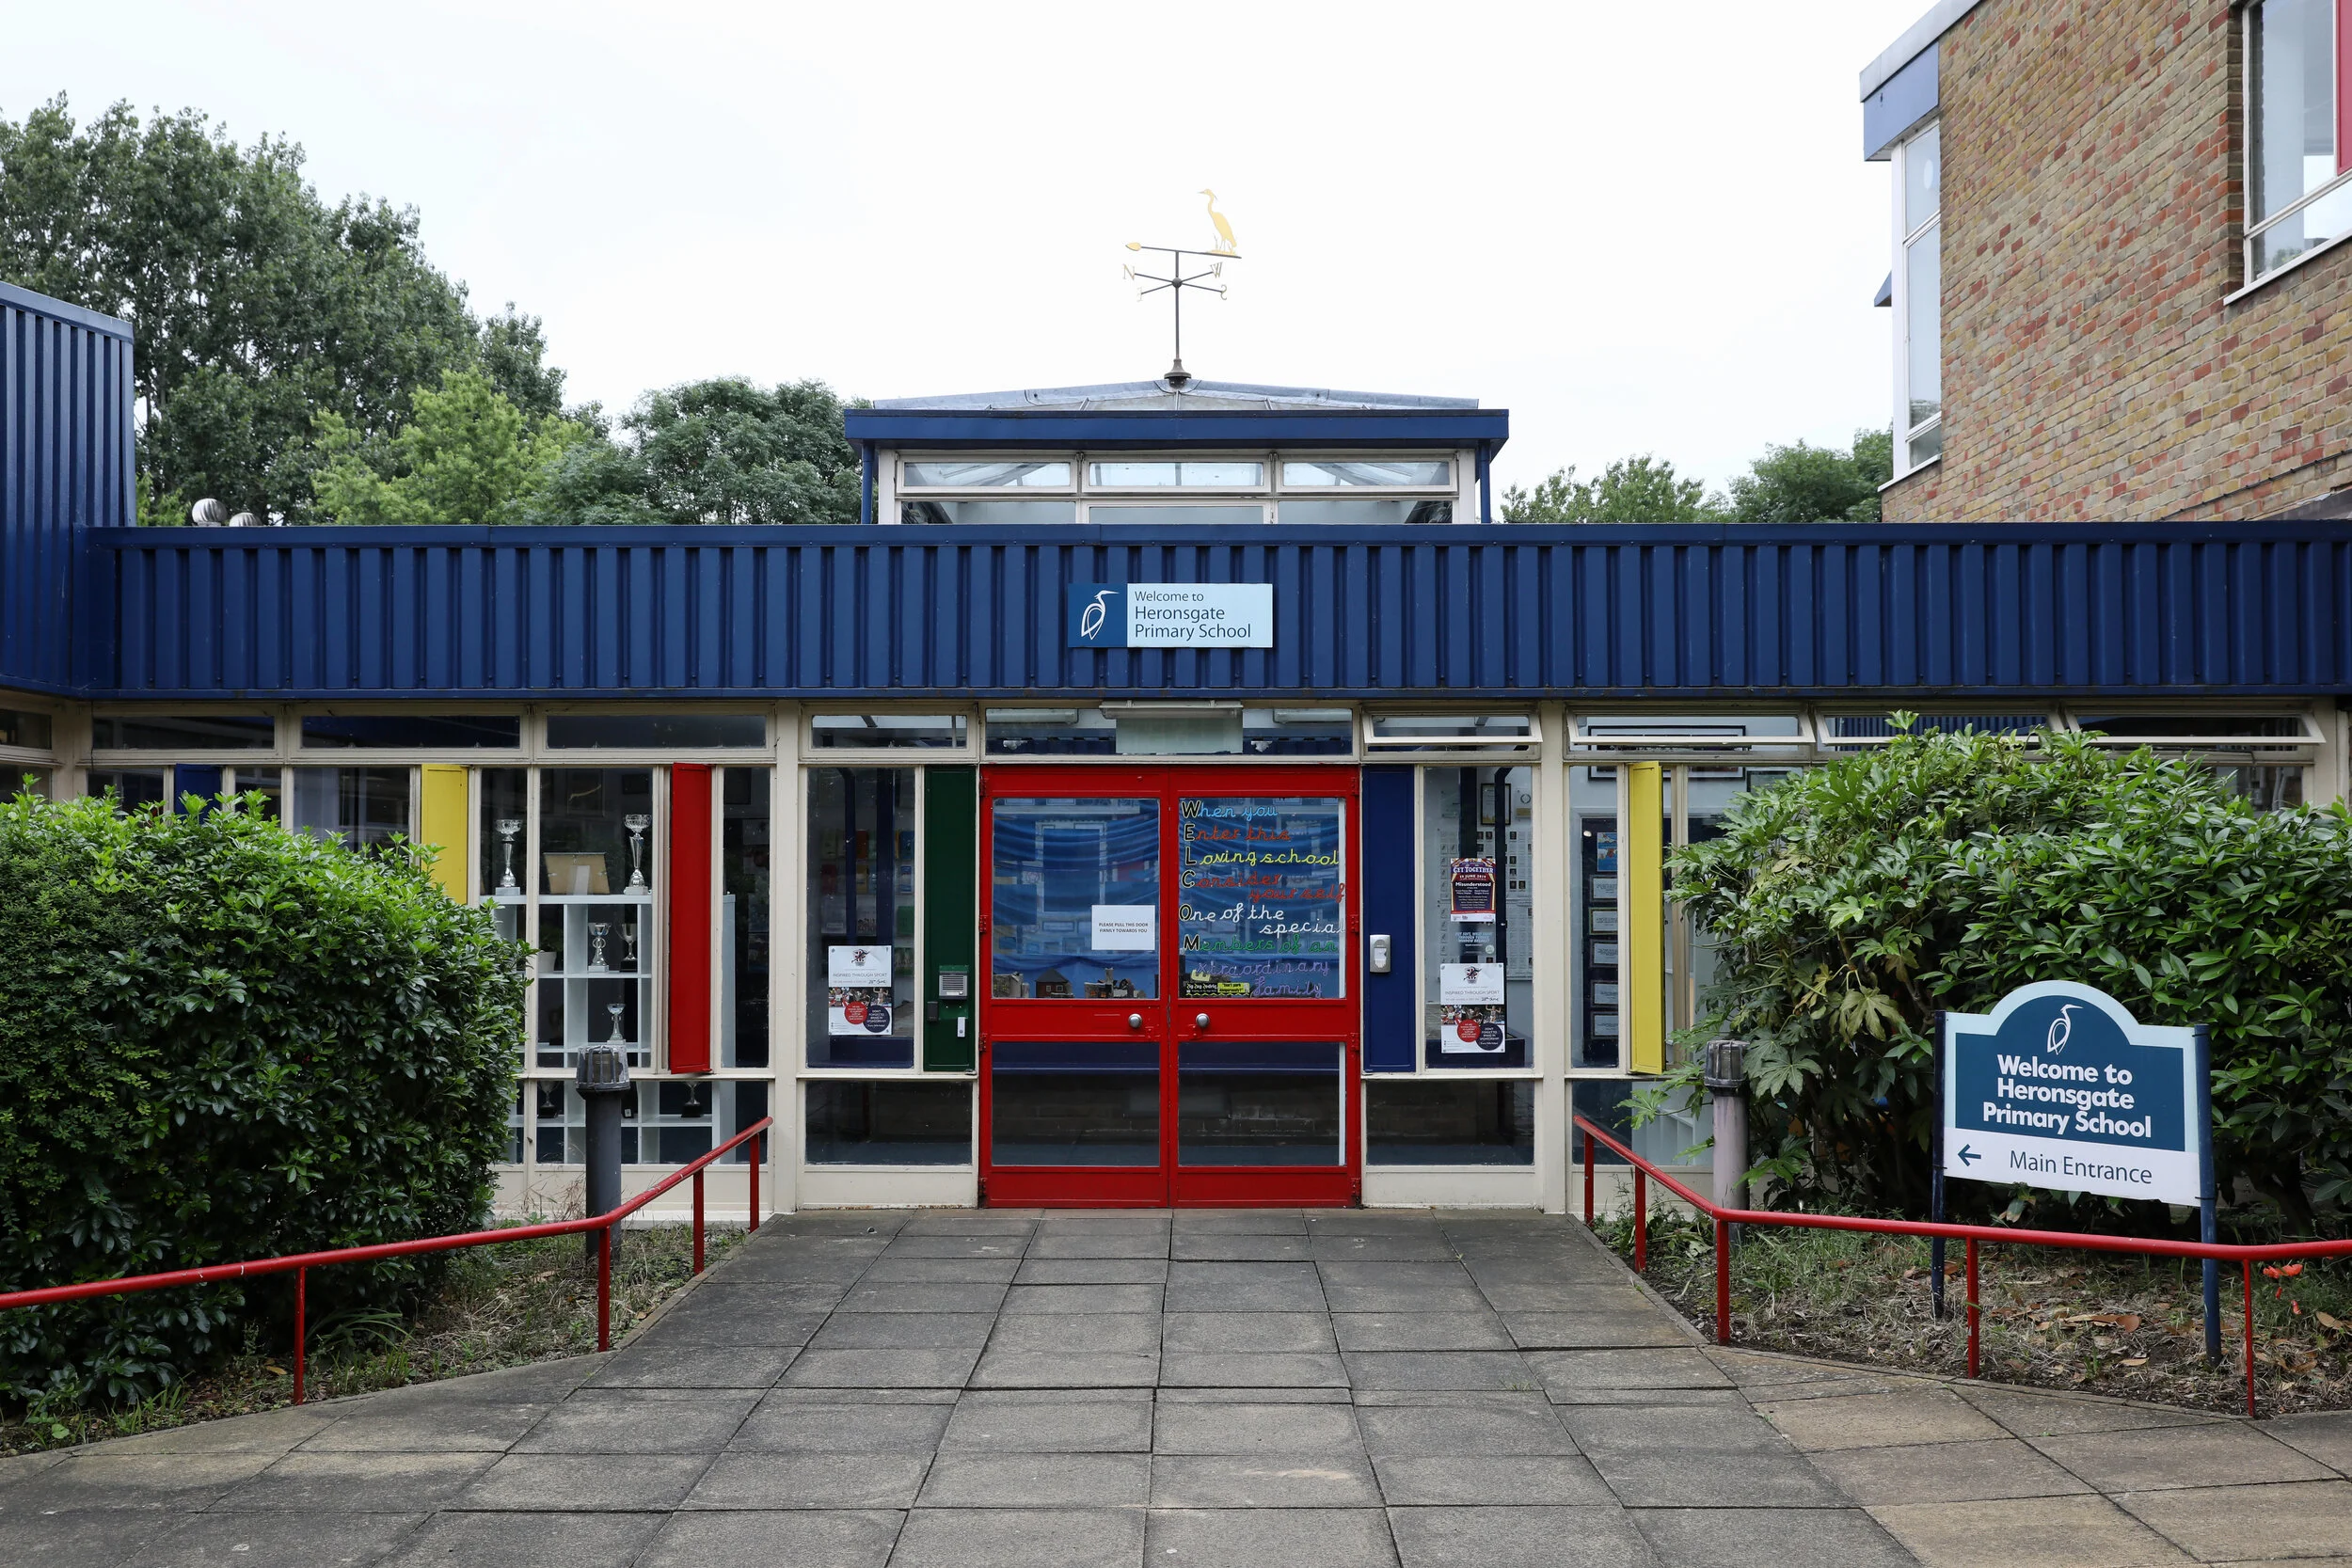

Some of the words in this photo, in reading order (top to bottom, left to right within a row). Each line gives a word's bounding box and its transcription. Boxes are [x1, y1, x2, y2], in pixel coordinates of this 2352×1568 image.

[1135, 591, 1189, 602] Welcome
[1192, 592, 1204, 602] to
[1135, 606, 1225, 623] Heronsgate
[1135, 624, 1195, 641] Primary
[1199, 623, 1251, 639] School
[1182, 800, 1236, 818] When
[1241, 805, 1279, 821] you
[1184, 824, 1240, 842] Enter
[1246, 829, 1292, 841] this
[1185, 847, 1257, 866] Loving
[1260, 848, 1340, 865] school
[1182, 870, 1281, 888] Consider
[1179, 905, 1216, 923] One
[1220, 903, 1244, 923] of
[1248, 905, 1284, 920] the
[1259, 918, 1346, 939] special
[1184, 934, 1275, 951] Members
[1279, 933, 1302, 954] of
[1310, 940, 1338, 952] an
[1252, 976, 1323, 999] family
[1996, 1053, 2099, 1083] Welcome
[2104, 1064, 2133, 1085] to
[1997, 1077, 2135, 1111] Heronsgate
[1983, 1101, 2070, 1135] Primary
[2074, 1111, 2152, 1138] School
[2010, 1150, 2057, 1174] Main
[2063, 1156, 2153, 1184] Entrance
